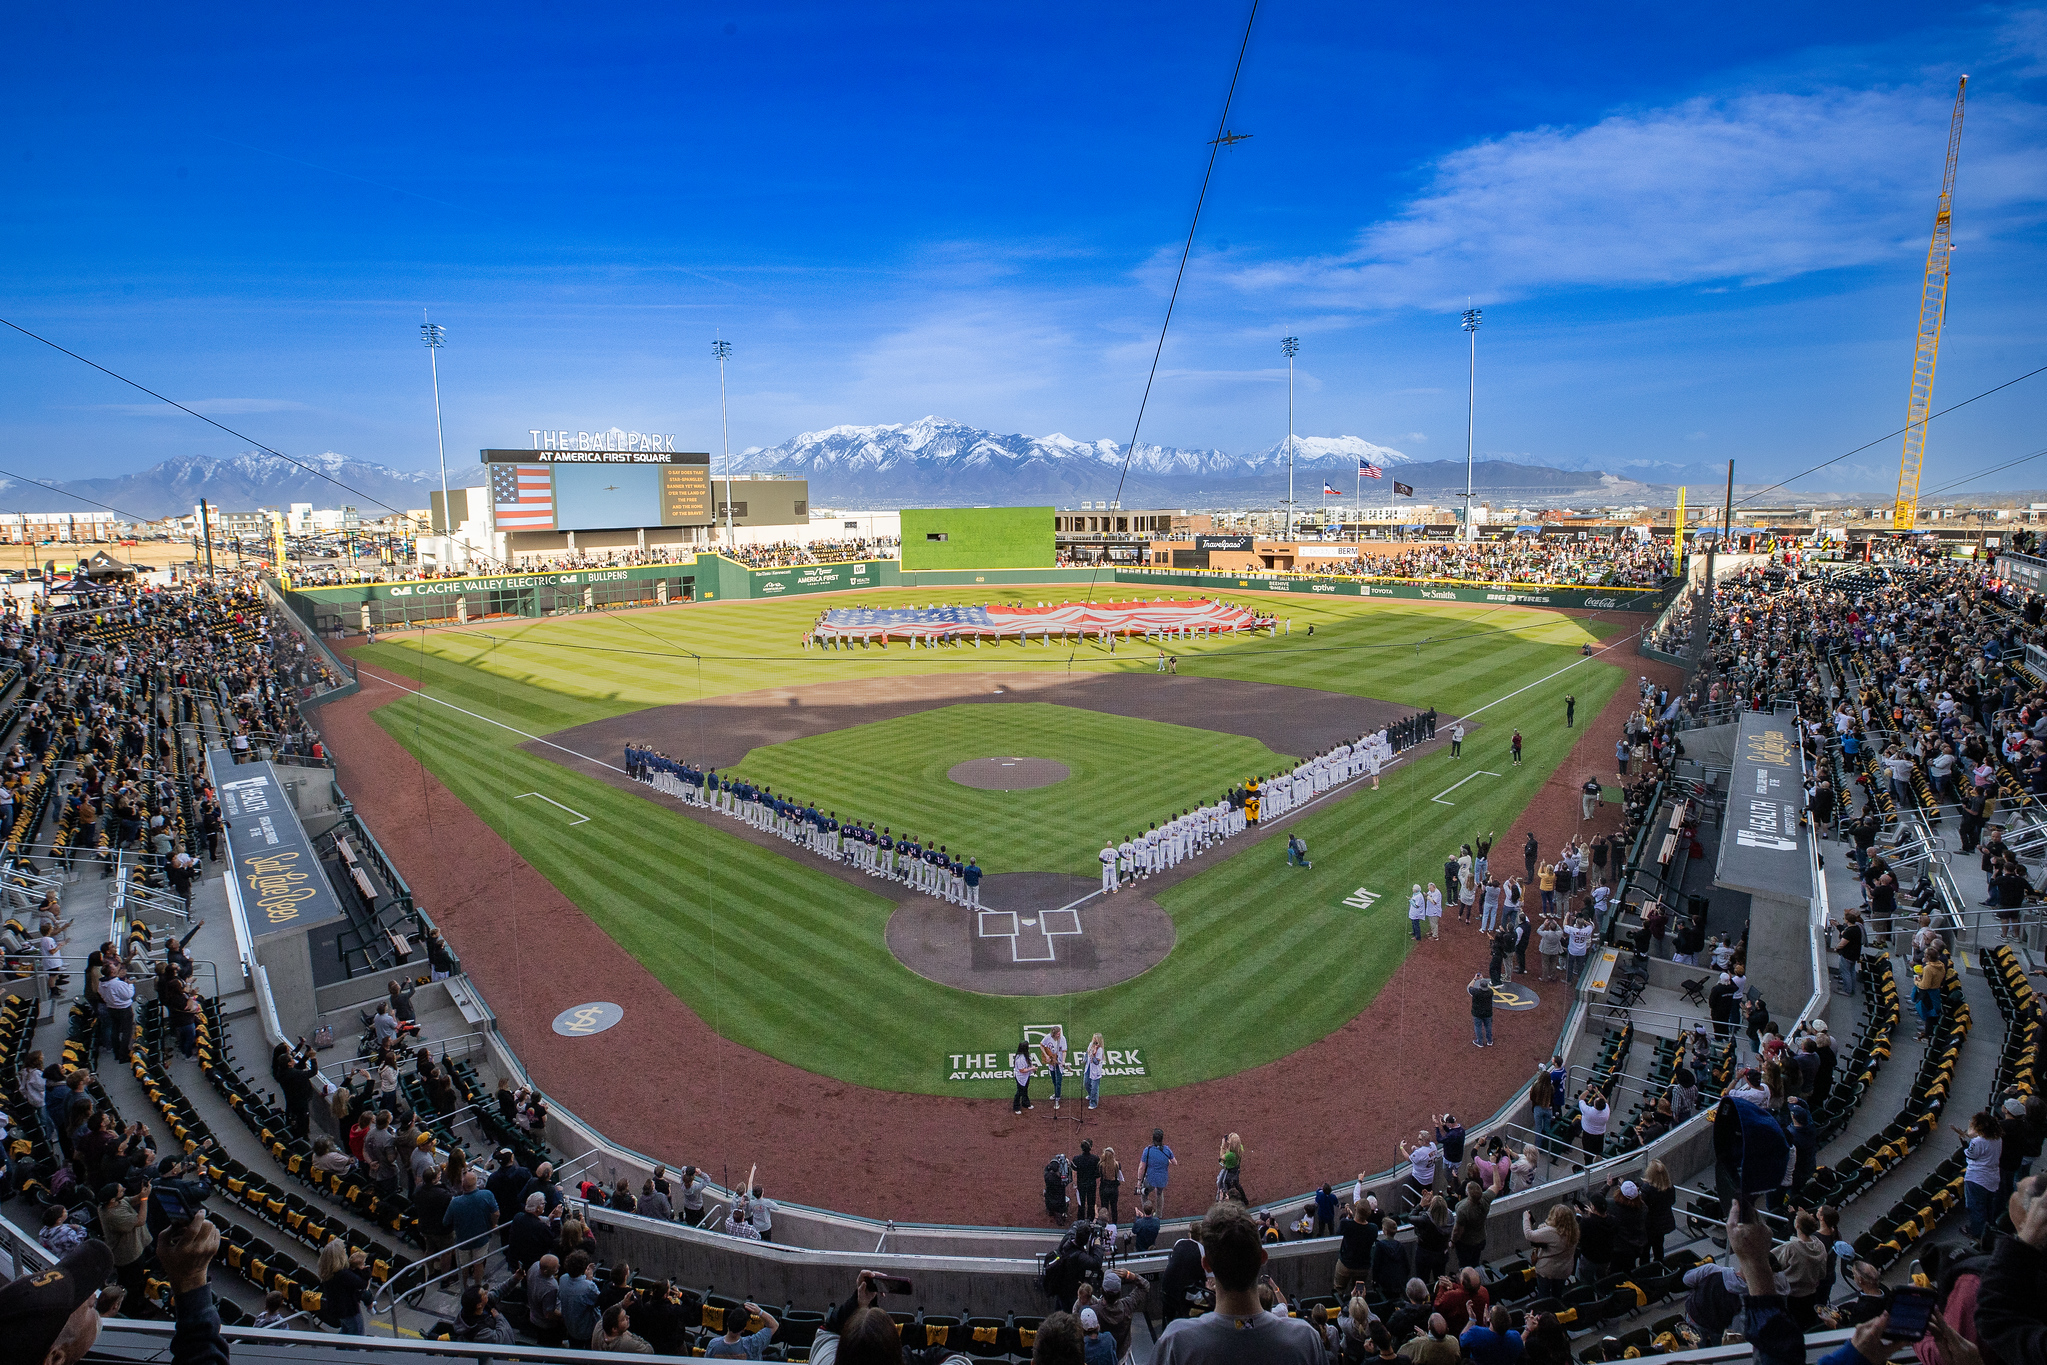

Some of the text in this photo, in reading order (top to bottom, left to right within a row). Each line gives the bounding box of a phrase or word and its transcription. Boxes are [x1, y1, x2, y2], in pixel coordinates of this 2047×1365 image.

[529, 430, 676, 452] THE BALLPARK
[538, 452, 672, 463] AT AMERICA FIRST SQUARE
[1202, 539, 1241, 550] Travelpass
[416, 582, 460, 595] CACHE
[463, 579, 503, 591] VALLEY
[507, 575, 556, 588] ELECTRIC
[588, 571, 628, 582] BULLPENS
[1431, 590, 1456, 600] Smith's
[240, 787, 270, 813] HEALTH
[1750, 800, 1777, 833] HEALTH
[245, 852, 316, 923] Salt Lake Bees
[949, 1054, 997, 1069] THE
[949, 1072, 968, 1080] AT
